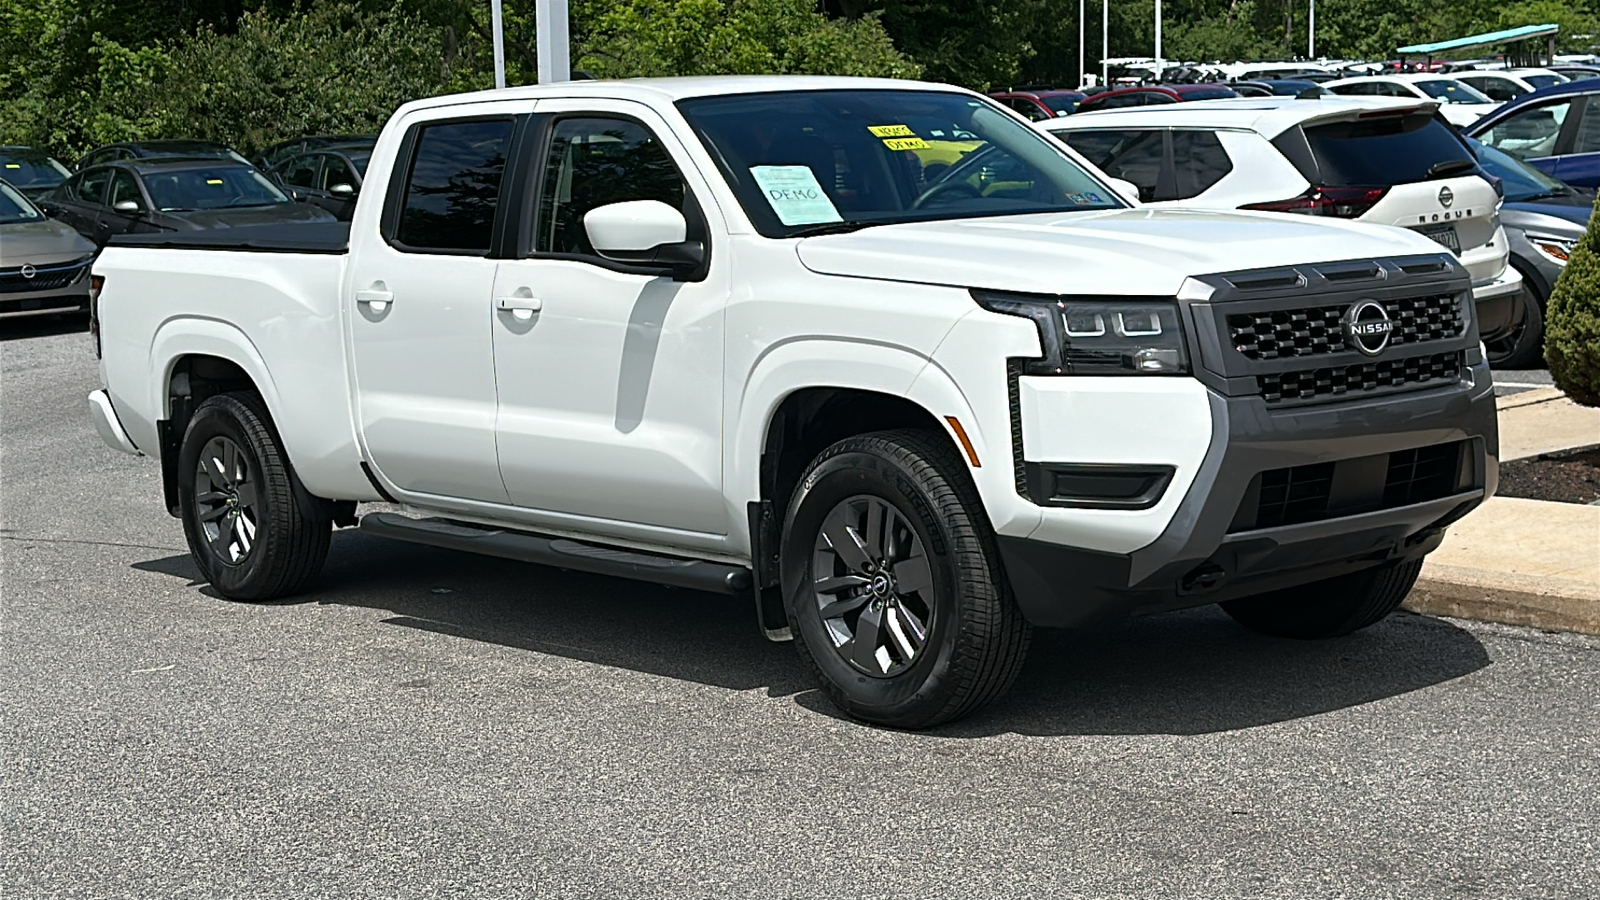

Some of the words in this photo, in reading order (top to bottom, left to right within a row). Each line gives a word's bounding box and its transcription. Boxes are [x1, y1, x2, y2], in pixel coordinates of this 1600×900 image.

[887, 140, 925, 149] DEMO
[769, 189, 817, 201] DEMO
[1419, 208, 1472, 223] ROGUE
[1351, 322, 1393, 335] NISSAN
